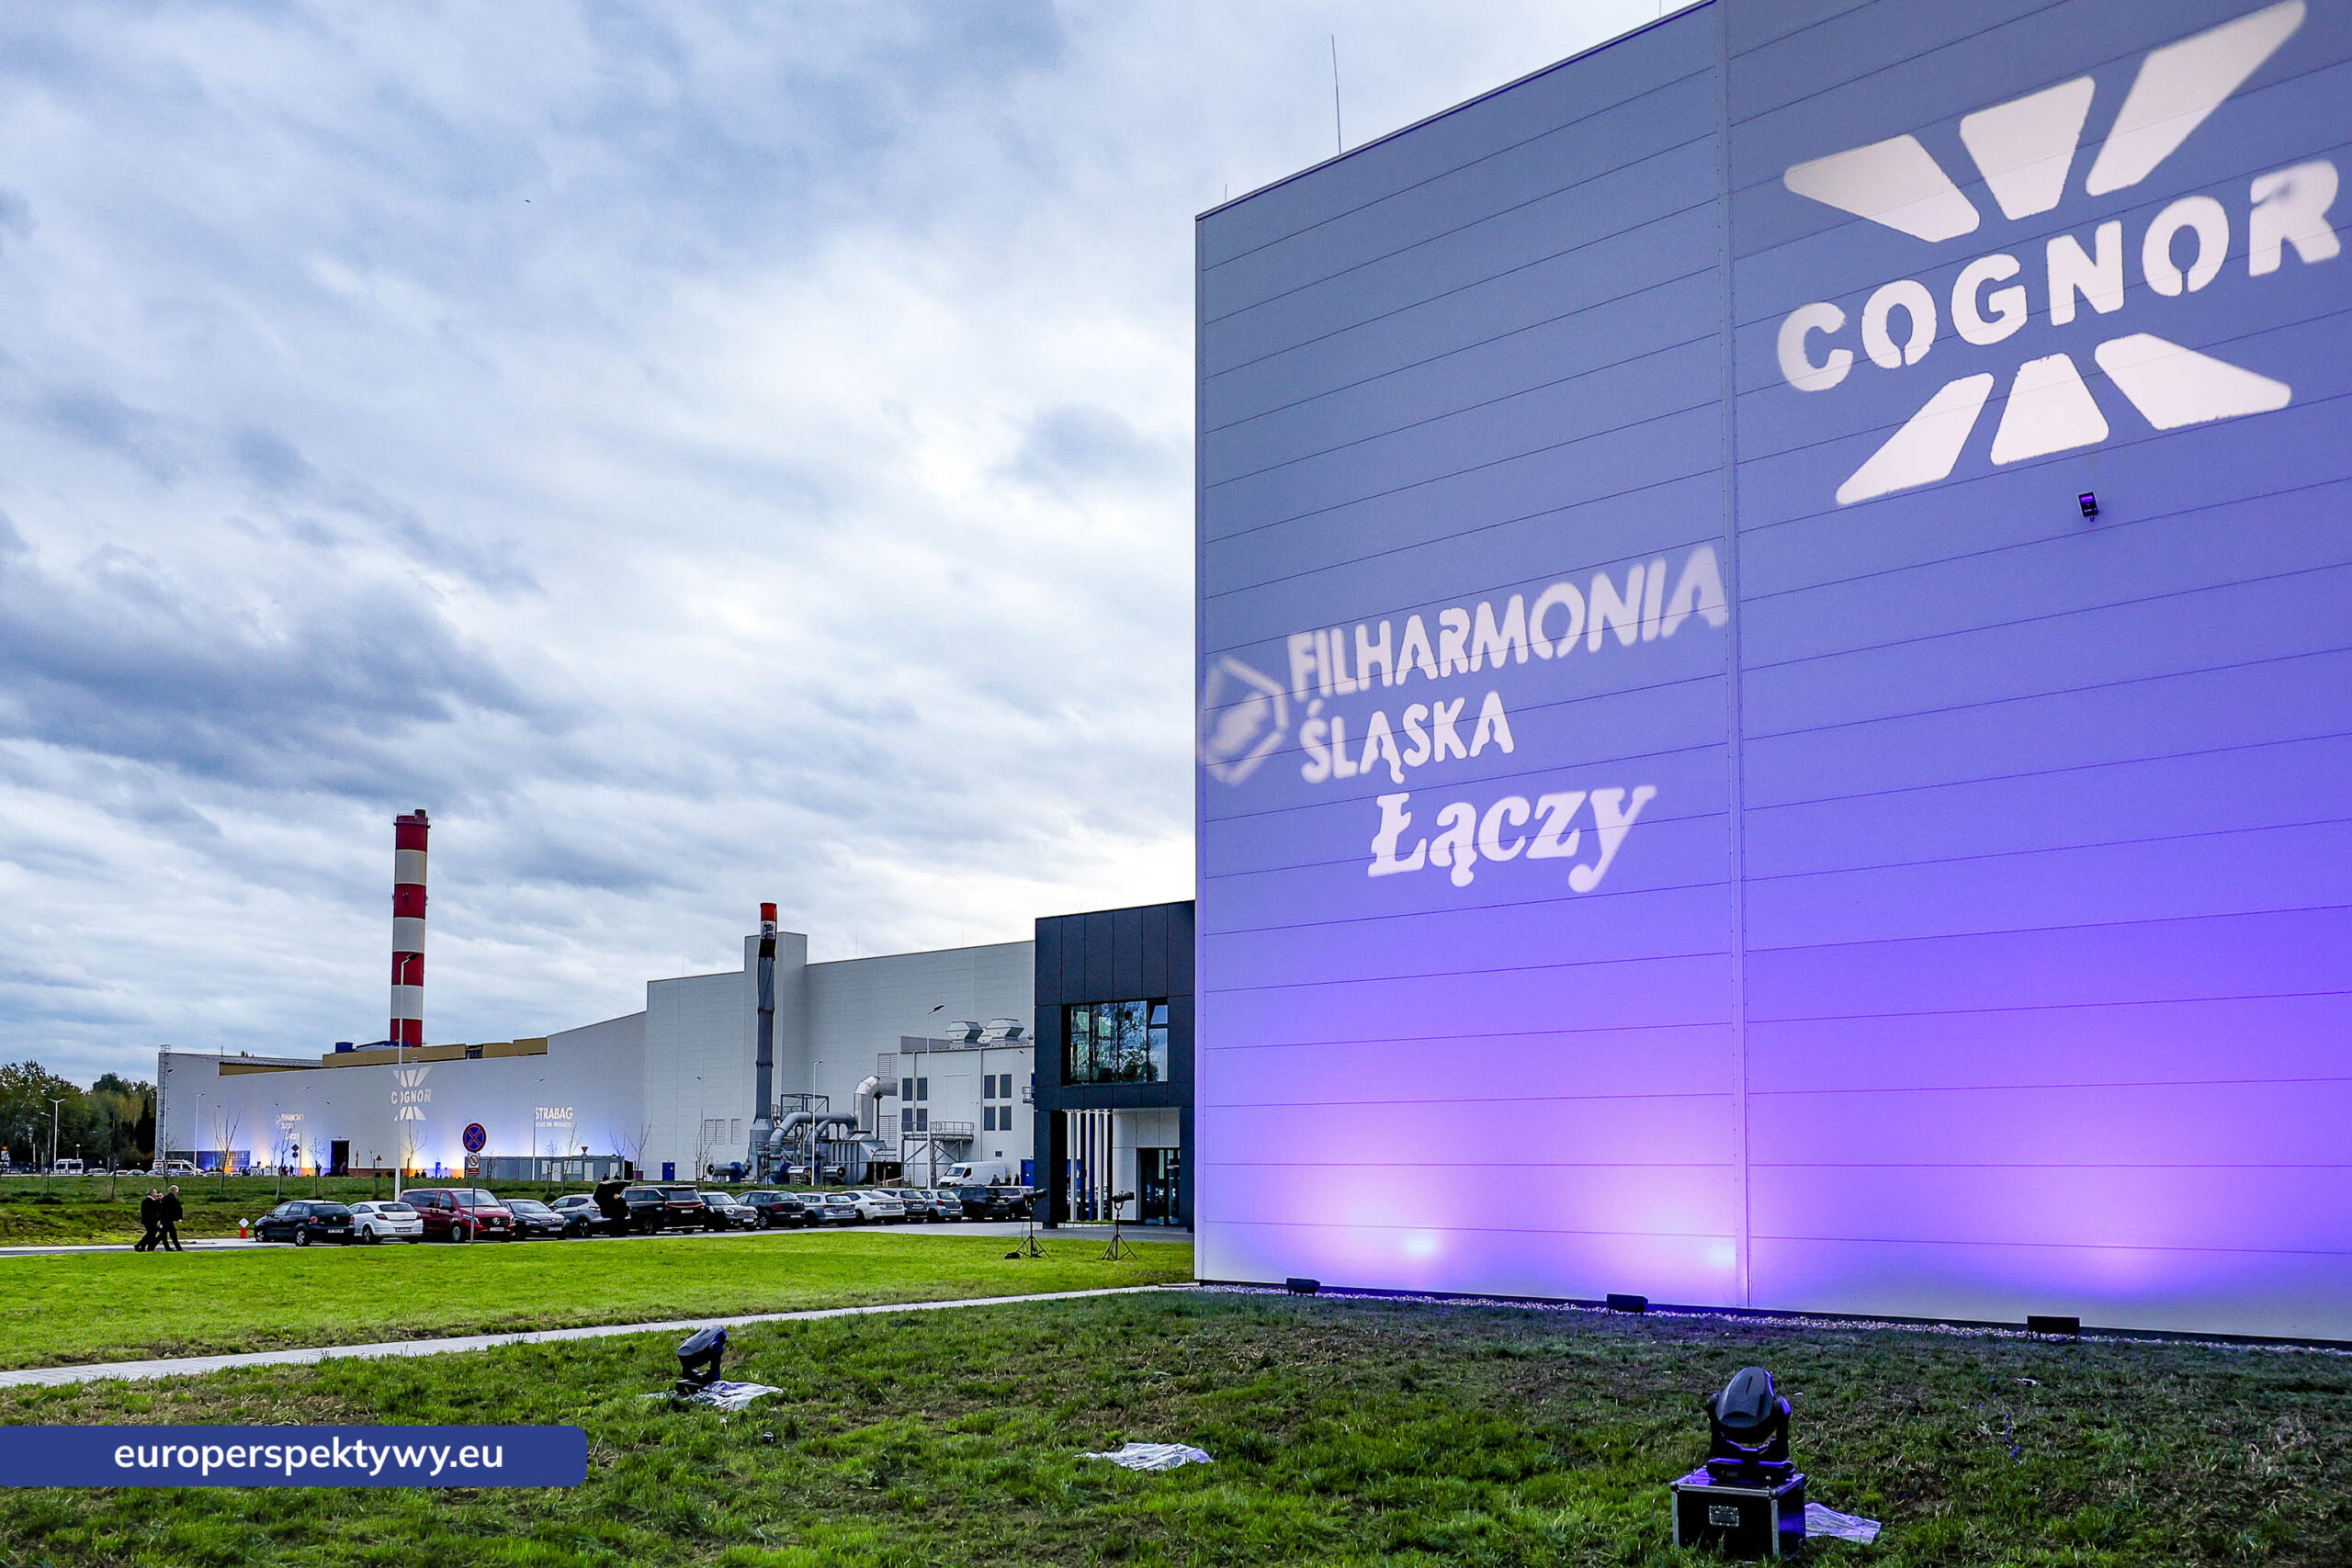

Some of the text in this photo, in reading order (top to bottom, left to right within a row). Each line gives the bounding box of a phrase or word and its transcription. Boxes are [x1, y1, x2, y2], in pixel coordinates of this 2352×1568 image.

[1777, 160, 2341, 392] COGNOR
[1286, 546, 1728, 701] FILHARMONIA
[1299, 691, 1515, 784] ŚLĄSKA
[1367, 784, 1657, 894] Łączy
[535, 1106, 573, 1121] STRABAG
